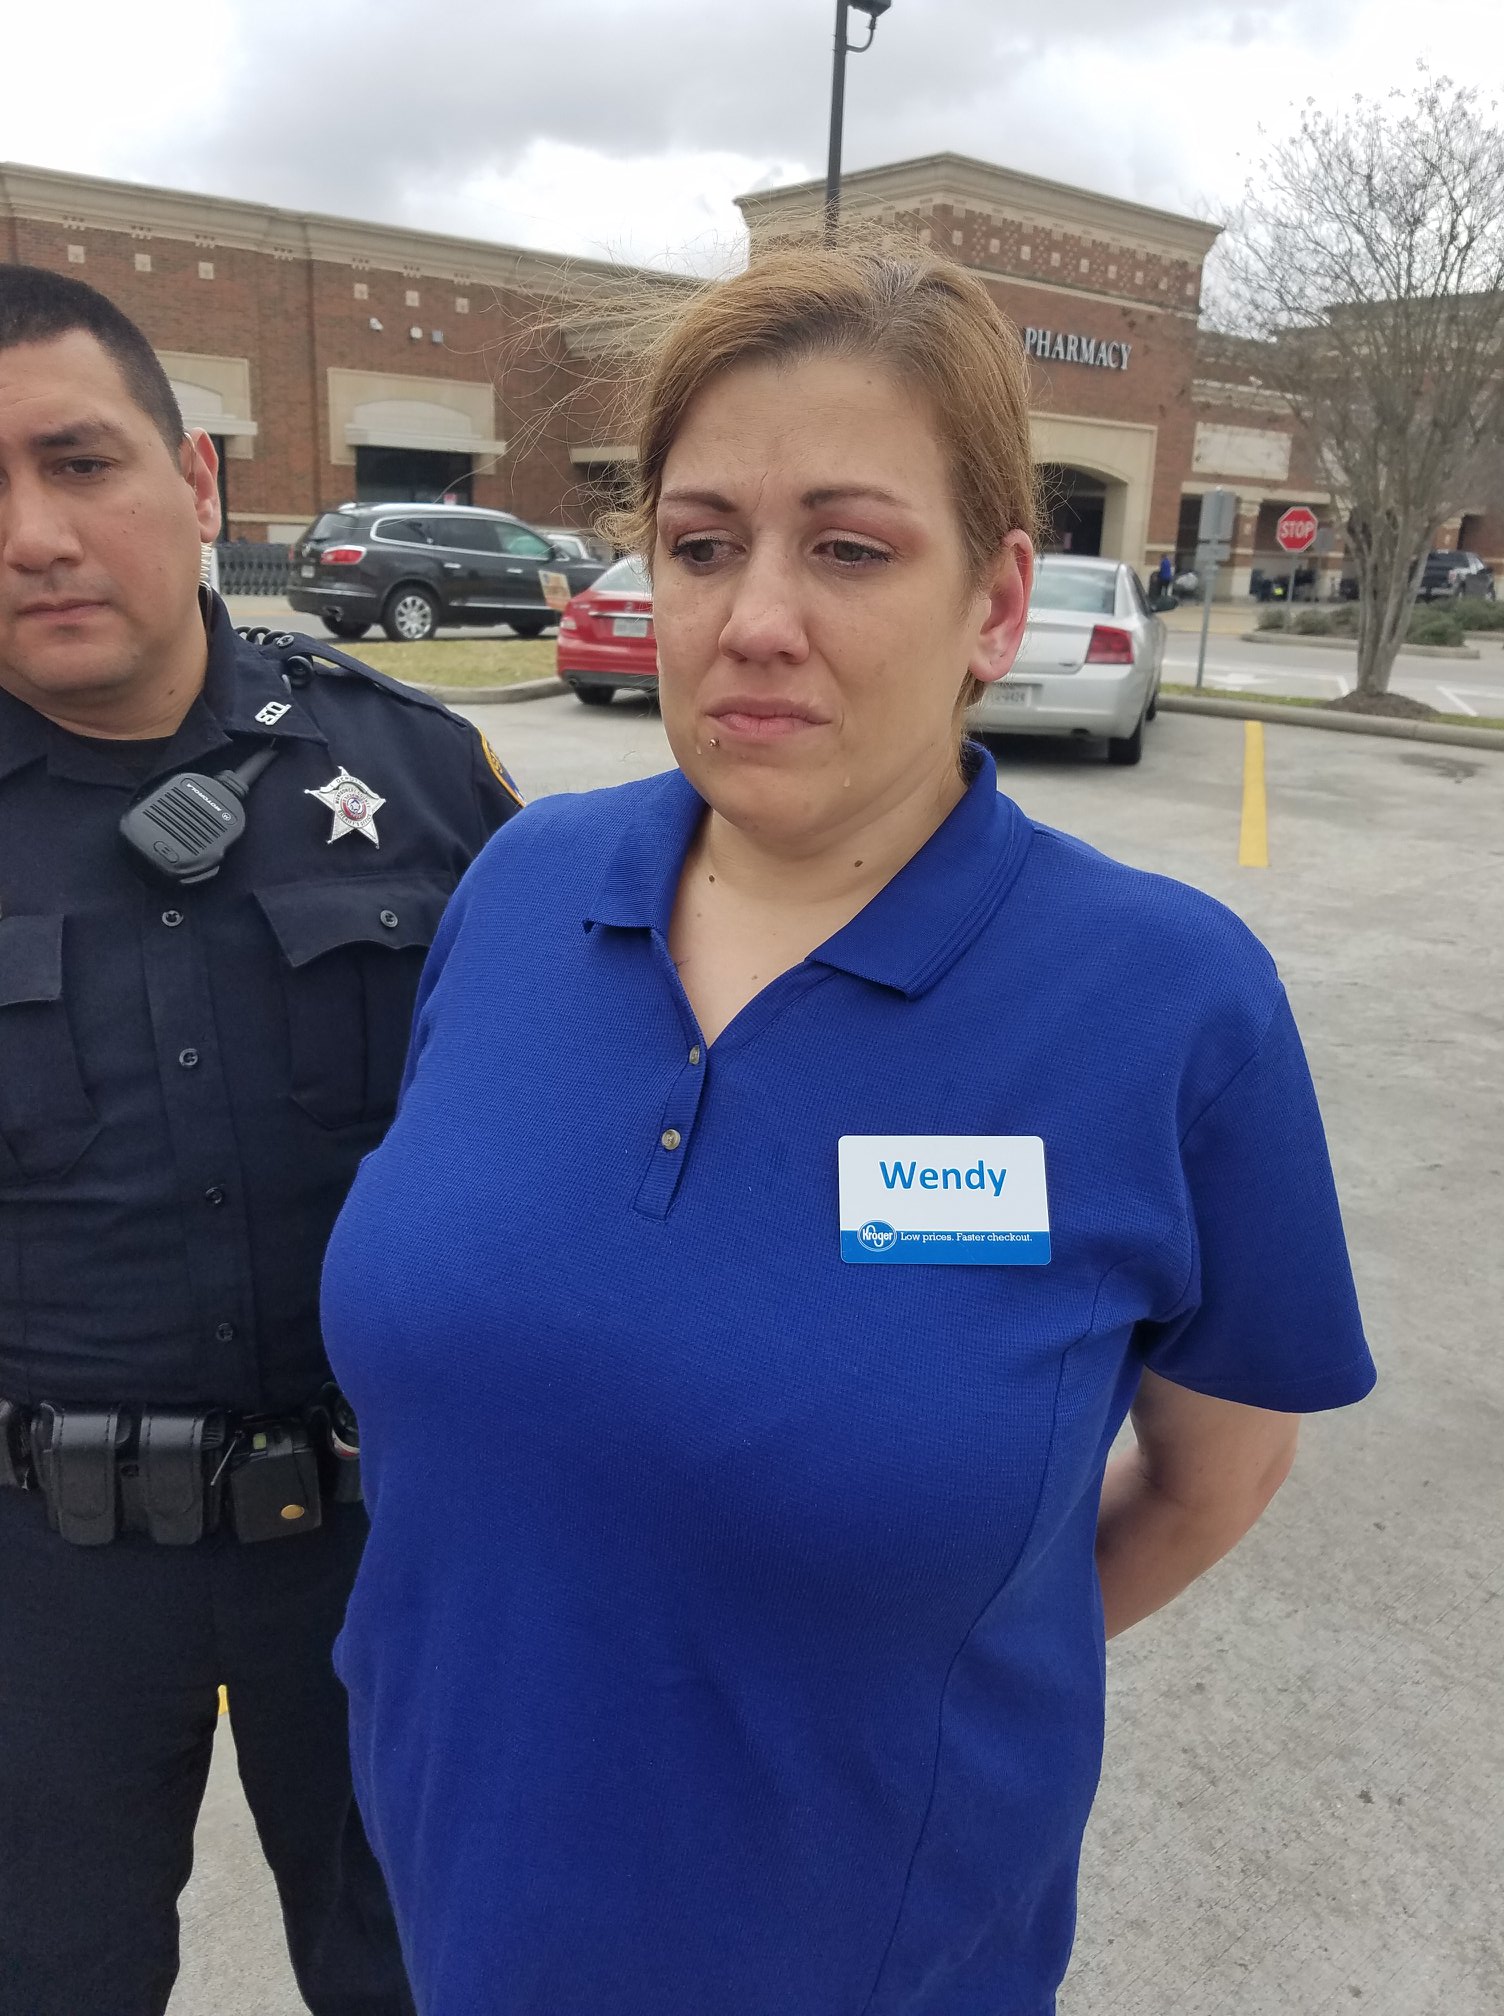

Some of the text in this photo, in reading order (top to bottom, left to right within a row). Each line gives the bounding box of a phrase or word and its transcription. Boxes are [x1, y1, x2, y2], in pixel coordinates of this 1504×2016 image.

[1024, 327, 1132, 370] PHARMACY
[1280, 520, 1315, 538] STOP
[186, 782, 222, 812] MOTOROLA
[879, 1160, 1007, 1197] Wendy
[862, 1224, 894, 1248] Kroger
[900, 1232, 1033, 1242] Low prices. Faster checkout.
